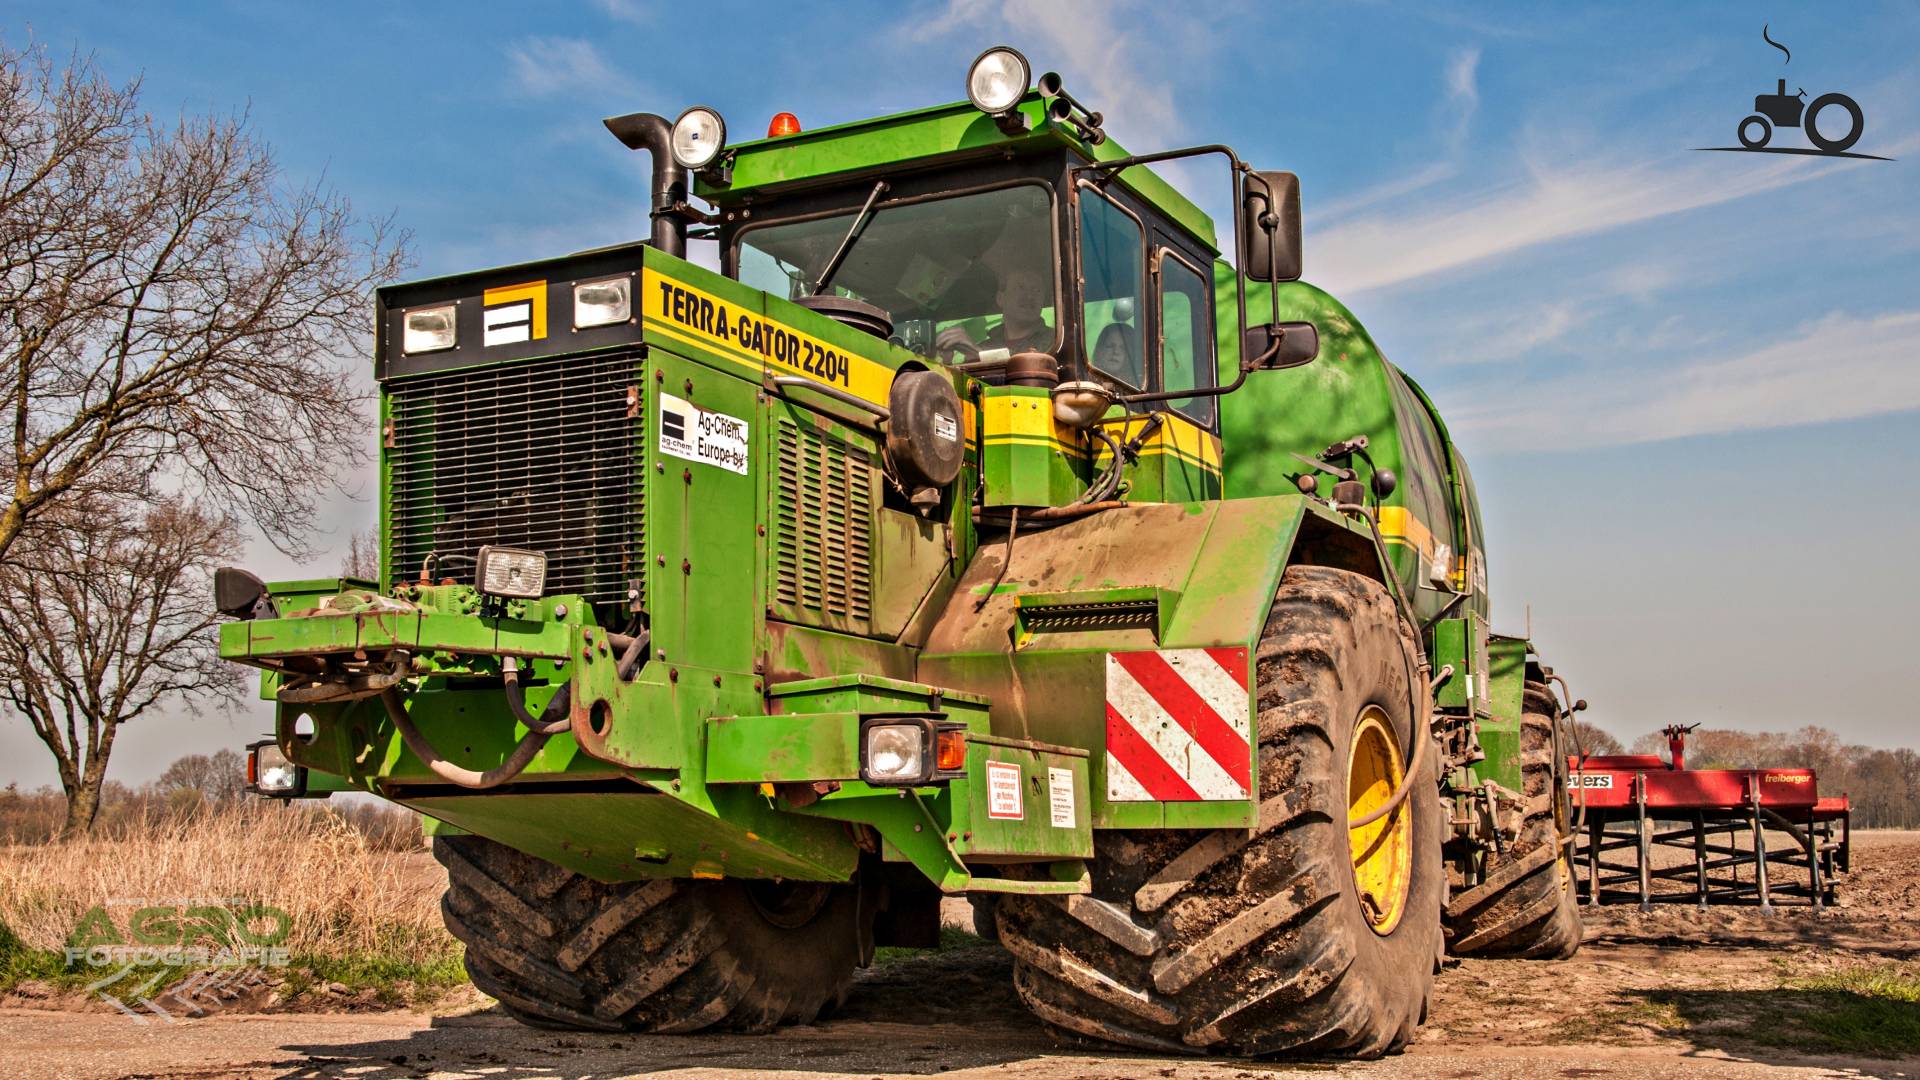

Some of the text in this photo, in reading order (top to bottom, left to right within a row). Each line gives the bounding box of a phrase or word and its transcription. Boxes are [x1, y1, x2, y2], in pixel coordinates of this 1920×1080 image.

[660, 281, 848, 387] TERRA-GATOR 2204
[698, 411, 740, 440] Ag-Chem
[698, 437, 730, 466] Europe
[1765, 774, 1811, 784] freiberger
